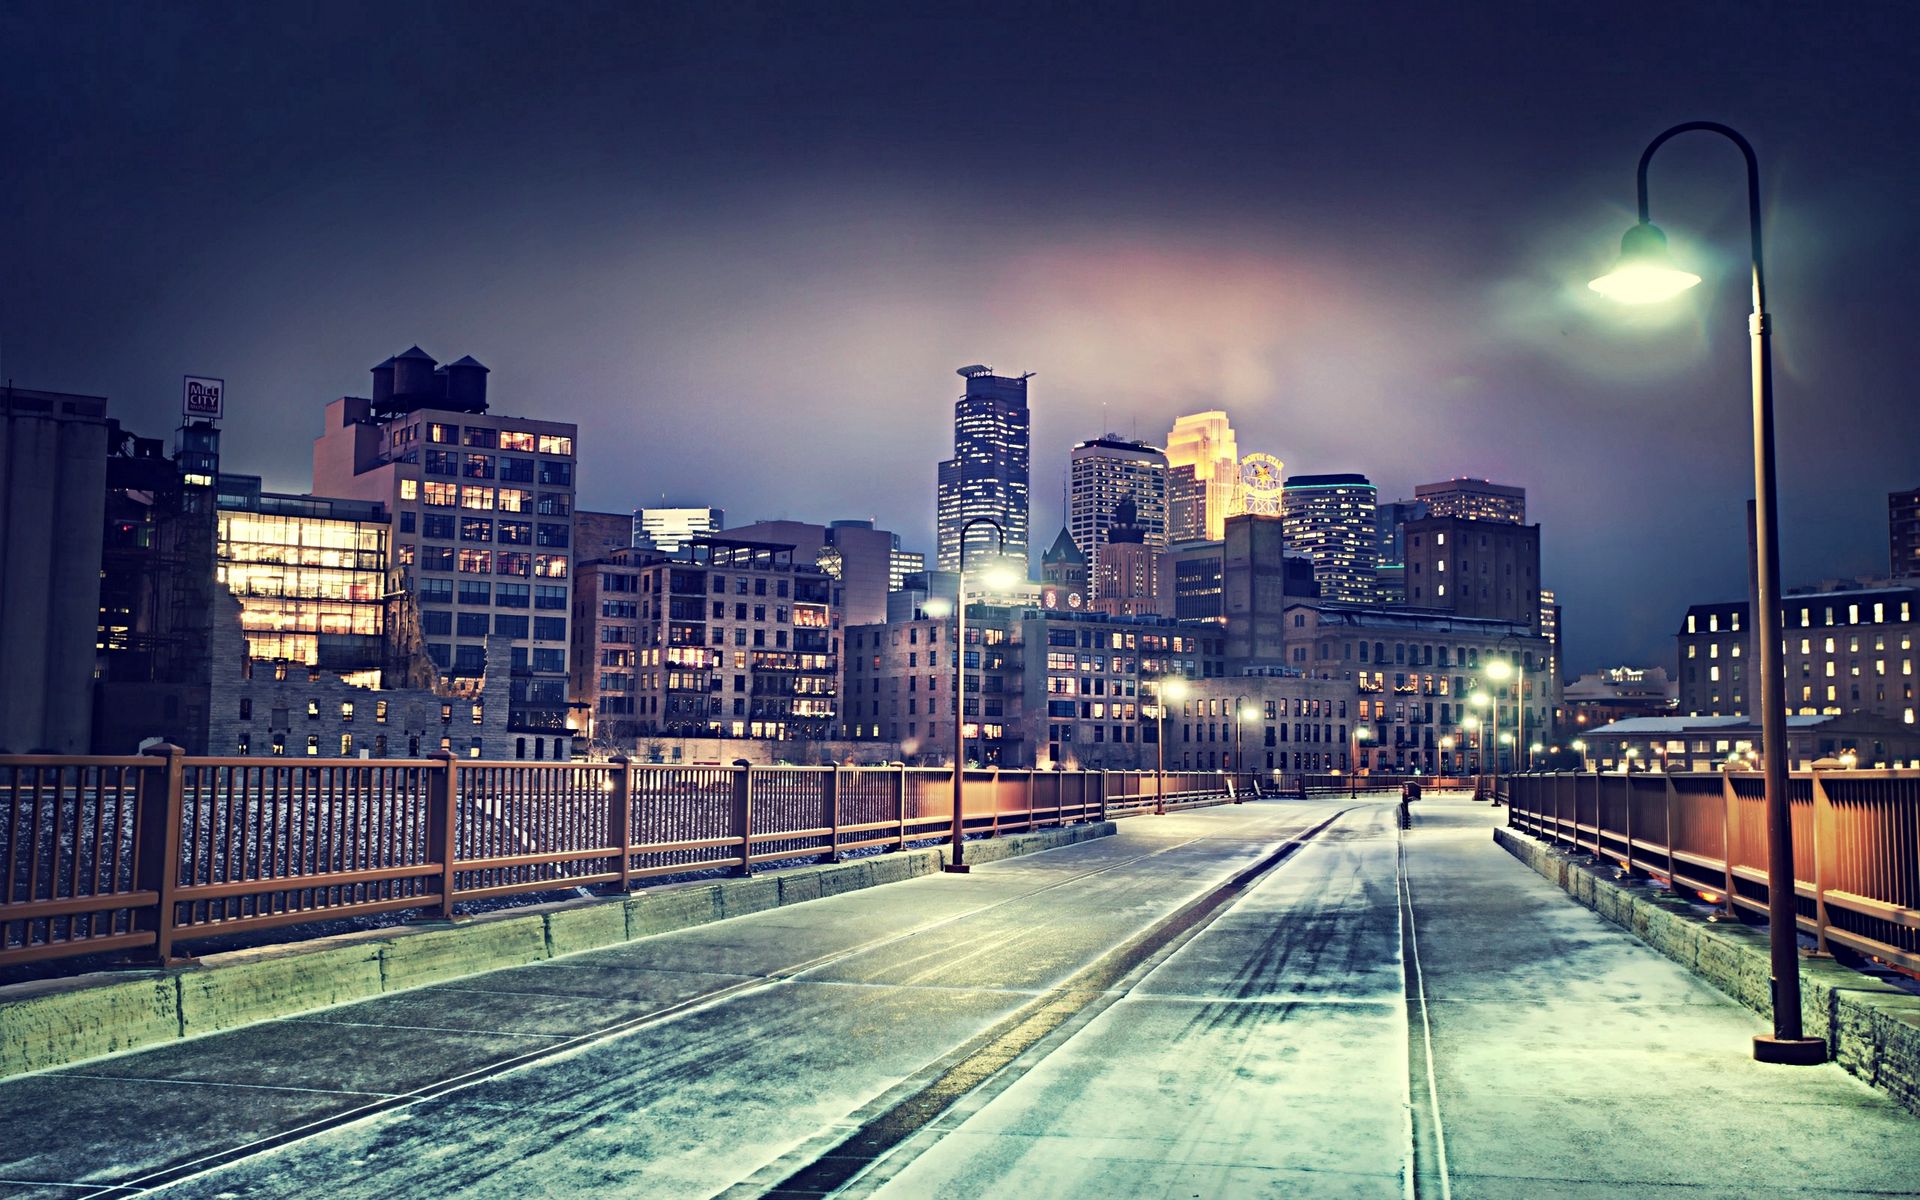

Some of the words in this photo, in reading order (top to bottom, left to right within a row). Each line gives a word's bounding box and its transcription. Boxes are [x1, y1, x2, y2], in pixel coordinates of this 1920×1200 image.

[190, 384, 218, 396] MILL
[190, 394, 217, 405] CITY
[1265, 454, 1284, 470] STAR
